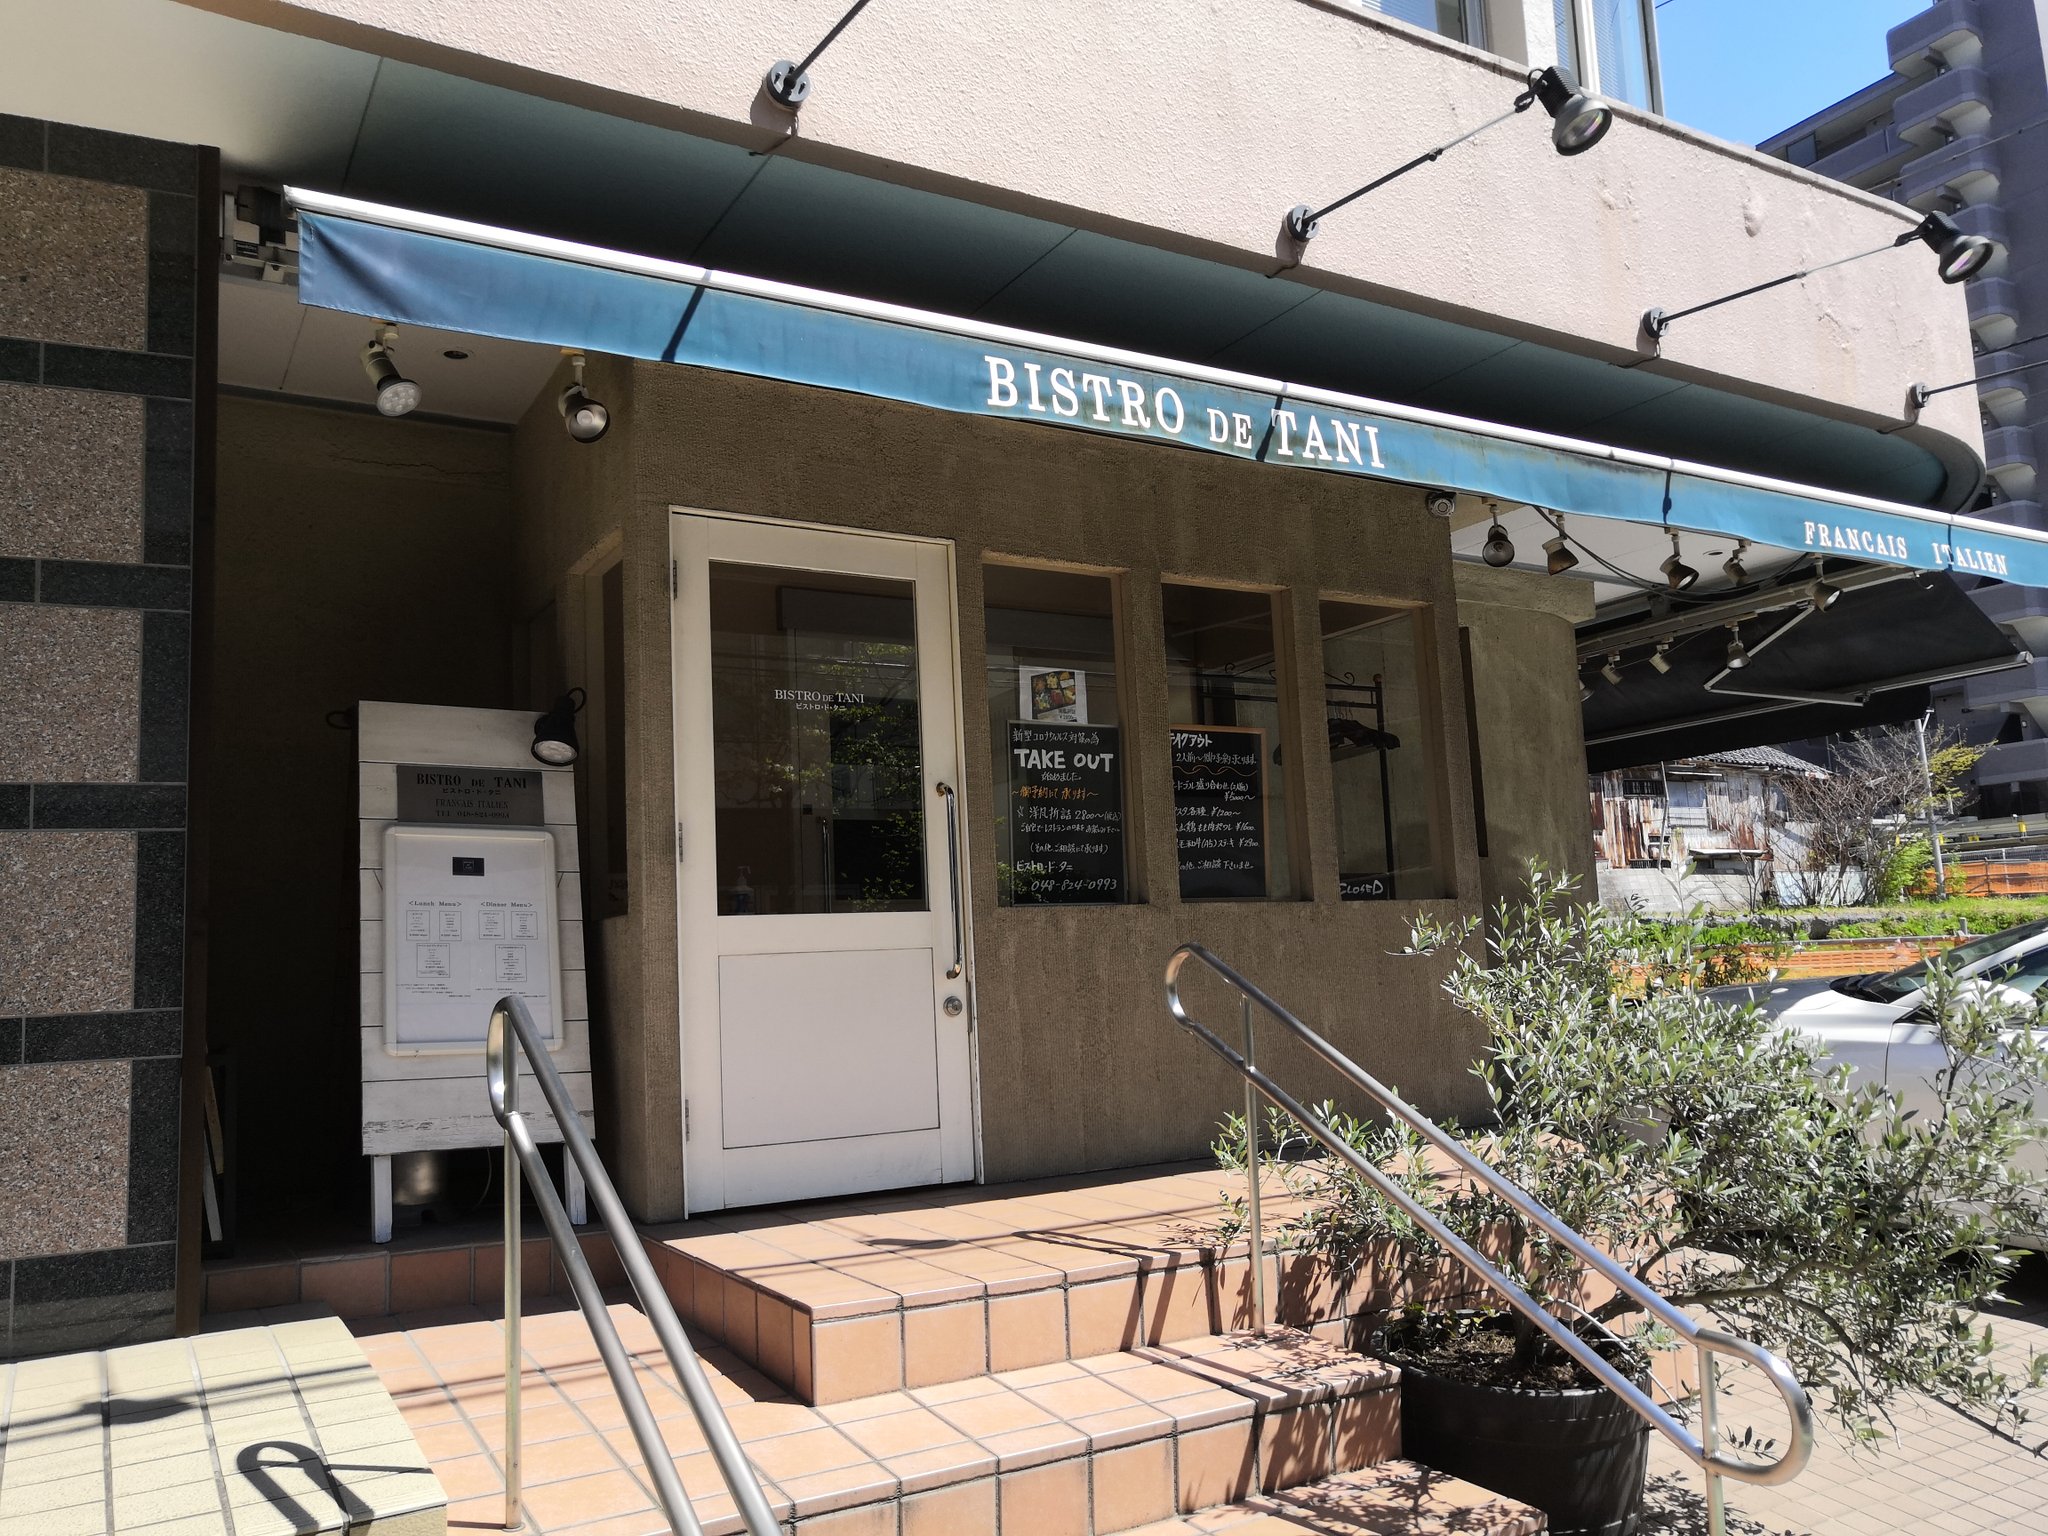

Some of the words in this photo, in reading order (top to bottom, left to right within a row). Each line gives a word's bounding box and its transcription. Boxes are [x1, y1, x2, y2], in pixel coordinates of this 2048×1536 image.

[984, 355, 1185, 434] BISTRO
[1206, 408, 1253, 450] DE
[1270, 409, 1385, 469] TANI
[1804, 521, 1908, 560] FRANCAIS
[1931, 542, 2008, 576] ITALIEN
[774, 689, 821, 702] BISTRO
[822, 694, 834, 702] DE
[835, 692, 865, 704] TANI
[796, 702, 847, 711] ビストロ・ド・タニ
[1013, 748, 1066, 770] TAKE
[1073, 753, 1114, 773] OUT
[416, 773, 462, 787] BISTRO
[471, 779, 486, 787] DE
[494, 776, 527, 789] TANI
[1177, 837, 1235, 849] 毛和牛(A5)ステーキ
[1031, 878, 1118, 891] 048-824-0993
[1339, 879, 1384, 895] CLOSED
